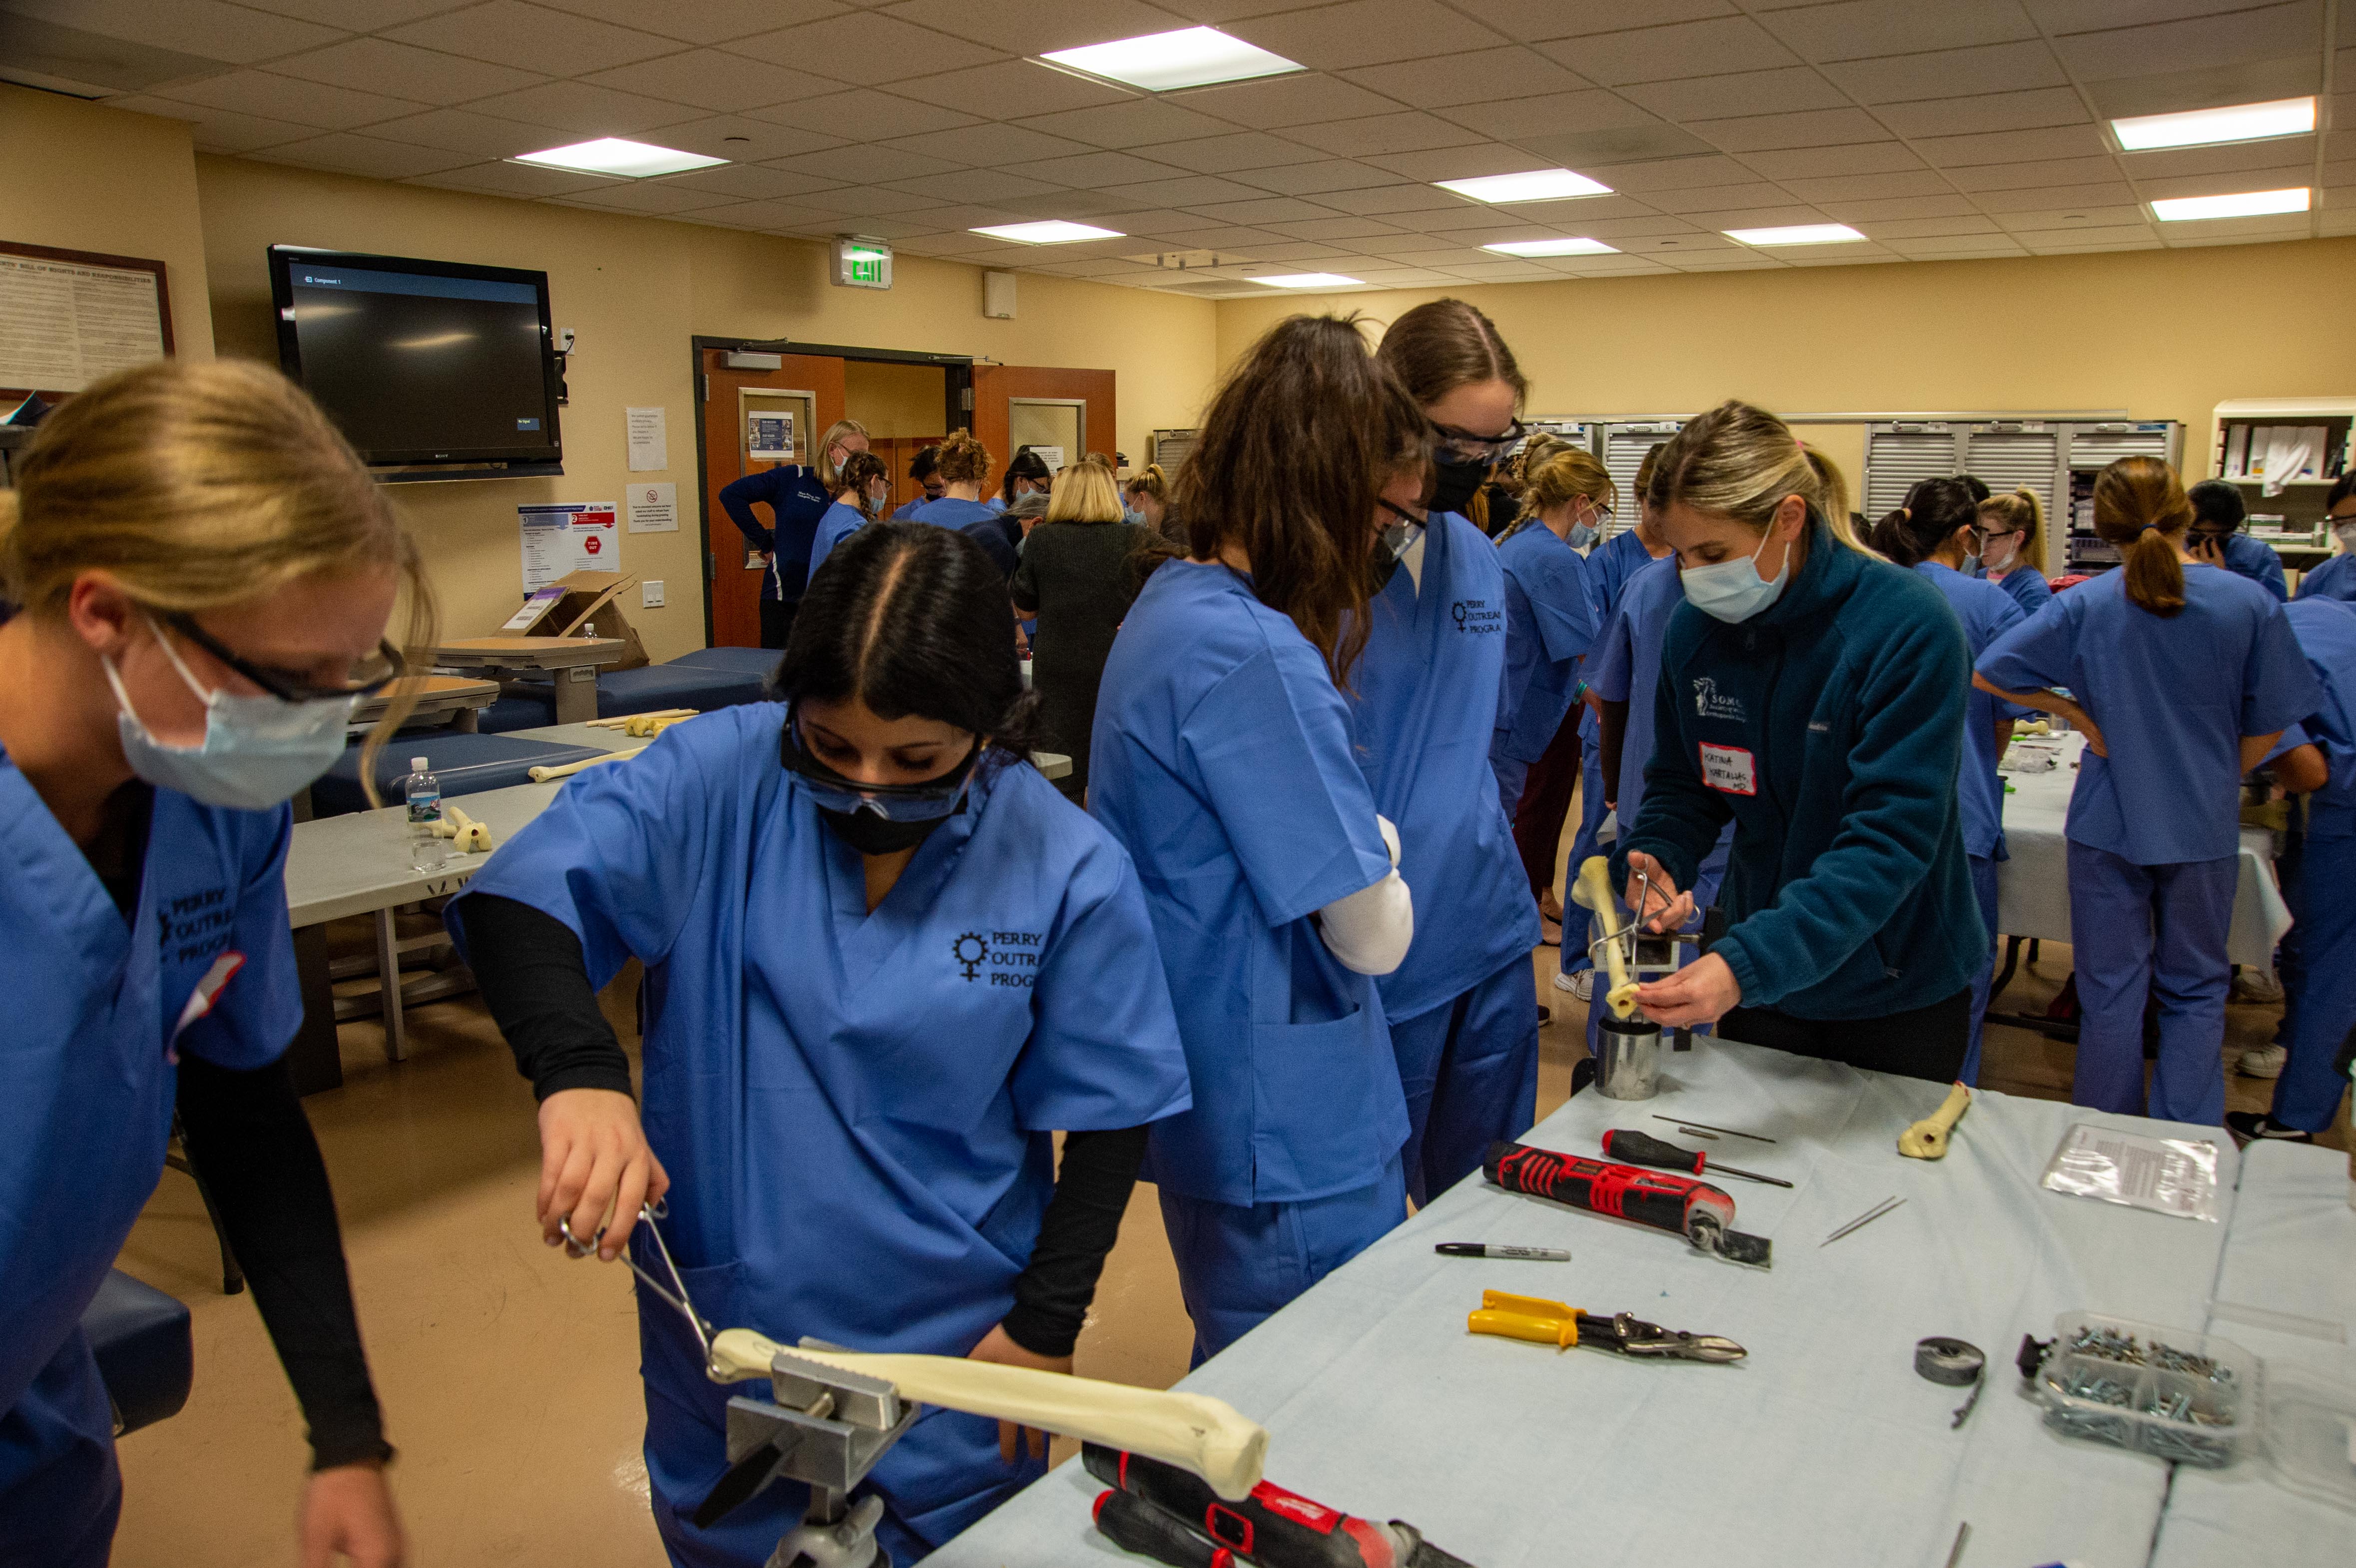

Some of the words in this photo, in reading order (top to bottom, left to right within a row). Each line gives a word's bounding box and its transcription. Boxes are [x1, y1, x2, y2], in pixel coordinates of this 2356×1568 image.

[852, 245, 883, 283] EXIT
[48, 267, 75, 275] RIGHTS
[91, 272, 151, 284] RESPONSIBILITIES
[170, 888, 226, 916] PERRY
[991, 932, 1042, 947] PERRY
[991, 952, 1040, 967] OUTR
